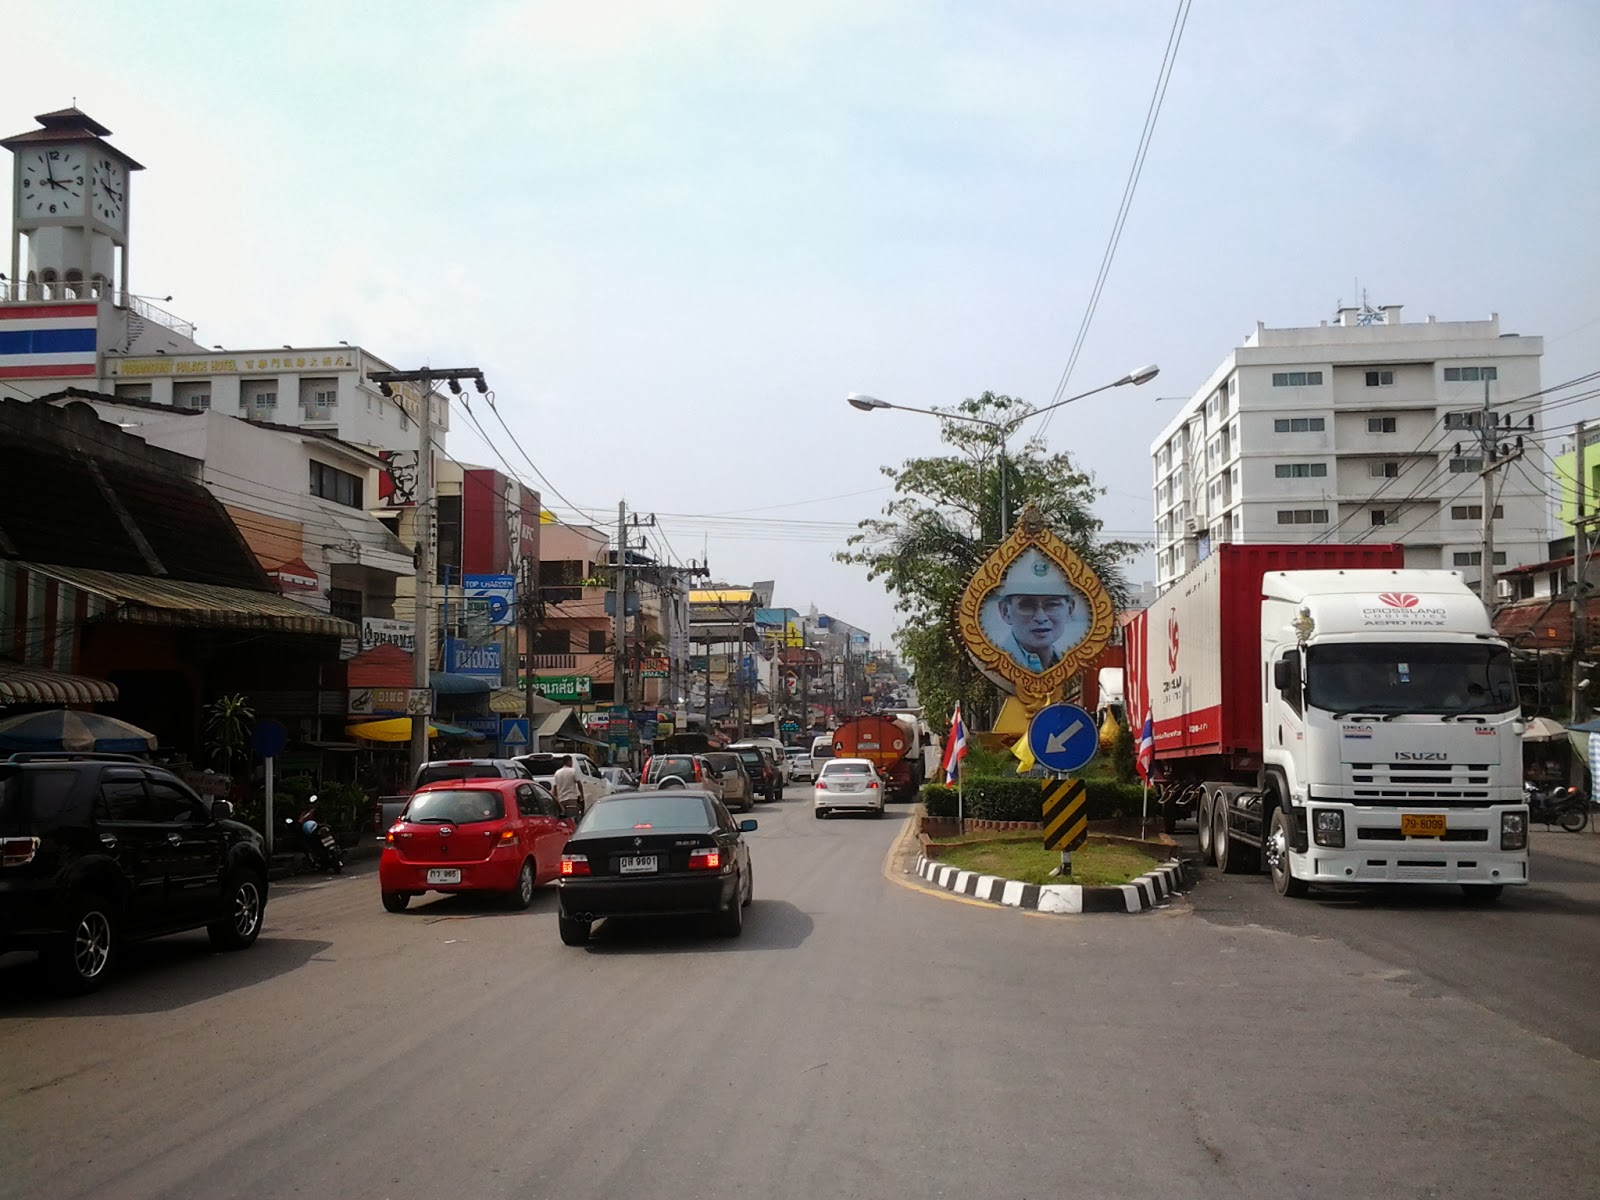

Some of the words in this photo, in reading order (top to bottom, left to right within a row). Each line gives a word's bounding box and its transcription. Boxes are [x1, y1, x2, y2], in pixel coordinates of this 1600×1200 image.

[49, 151, 59, 160] 12
[23, 179, 30, 188] 9
[76, 177, 84, 186] 3
[49, 205, 56, 213] 6
[211, 359, 237, 372] HOTEL
[521, 523, 534, 542] KFC
[836, 742, 842, 750] A
[1395, 752, 1447, 760] ISUZU
